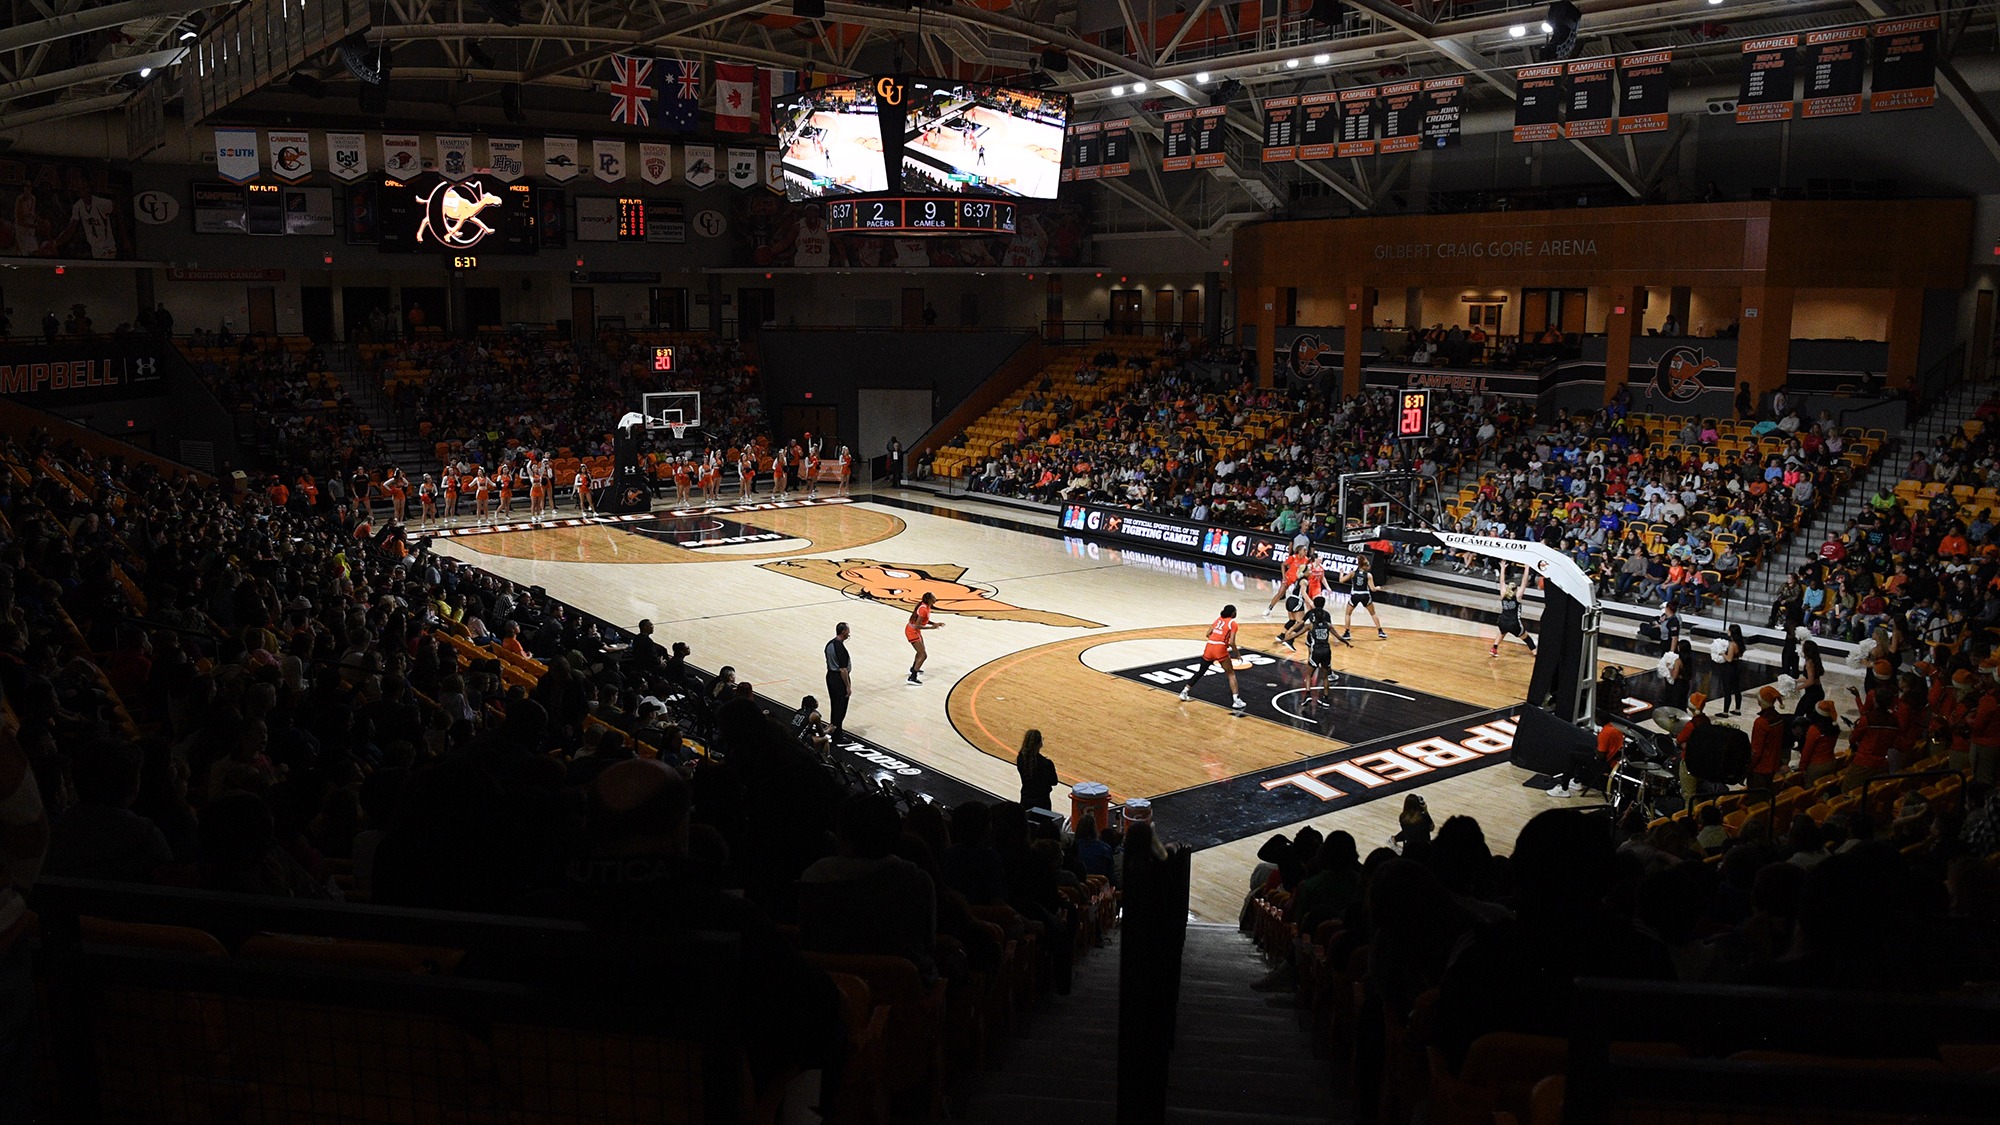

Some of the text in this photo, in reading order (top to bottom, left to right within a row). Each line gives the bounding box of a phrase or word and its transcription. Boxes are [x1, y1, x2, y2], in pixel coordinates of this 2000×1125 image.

[1877, 20, 1936, 34] CAMPBELL
[1809, 29, 1863, 42] CAMPBELL
[1744, 37, 1795, 50] CAMPBELL
[1623, 54, 1669, 65] CAMPBELL
[1569, 60, 1612, 72] CAMPBELL
[1519, 68, 1560, 77] CAMPBELL
[1574, 73, 1607, 84] SOFTBALL
[1628, 67, 1664, 78] SOFTBALL
[1383, 84, 1418, 94] CAMPBELL
[1425, 79, 1462, 89] CAMPBELL
[1522, 80, 1555, 88] SOFTBALL
[877, 77, 903, 105] CU
[1341, 90, 1375, 99] CAMPBELL
[1265, 99, 1296, 108] CAMPBELL
[1302, 95, 1335, 104] CAMPBELL
[1808, 101, 1856, 110] TOURNAMENT
[1875, 96, 1929, 107] TOURNAMENT
[1164, 111, 1192, 120] CAMPBELL
[1196, 107, 1224, 116] CAMPBELL
[1439, 106, 1460, 114] JOHN
[1425, 113, 1459, 123] CROOKS
[1104, 120, 1129, 129] CAMPBELL
[1622, 121, 1664, 130] TOURNAMENT
[220, 148, 254, 157] SOUTH
[336, 150, 358, 166] CSU
[491, 155, 522, 175] HPU
[599, 153, 619, 175] PC
[139, 193, 169, 222] CU
[833, 202, 1012, 224] 6:37 2 9 6:37 2
[700, 212, 719, 236] CU
[1375, 240, 1597, 259] GILBERT CRAIG GORE ARENA
[454, 257, 477, 268] 6:37
[656, 349, 672, 357] 6:37
[655, 356, 671, 370] 20
[0, 359, 119, 394] MPBELL
[1407, 373, 1489, 391] CAMPBELL
[1404, 394, 1425, 409] 6:37
[1401, 409, 1422, 433] 20
[1087, 511, 1101, 530] G
[1132, 518, 1153, 527] OFFICIAL
[1153, 522, 1170, 530] SPORTS
[1190, 528, 1200, 536] THE
[1121, 523, 1198, 547] FIGHTING CAMELS
[1231, 535, 1247, 556] G
[1274, 543, 1284, 551] THE
[1331, 553, 1346, 561] FUEL
[1346, 556, 1355, 564] OF
[566, 861, 672, 883] UTICA
